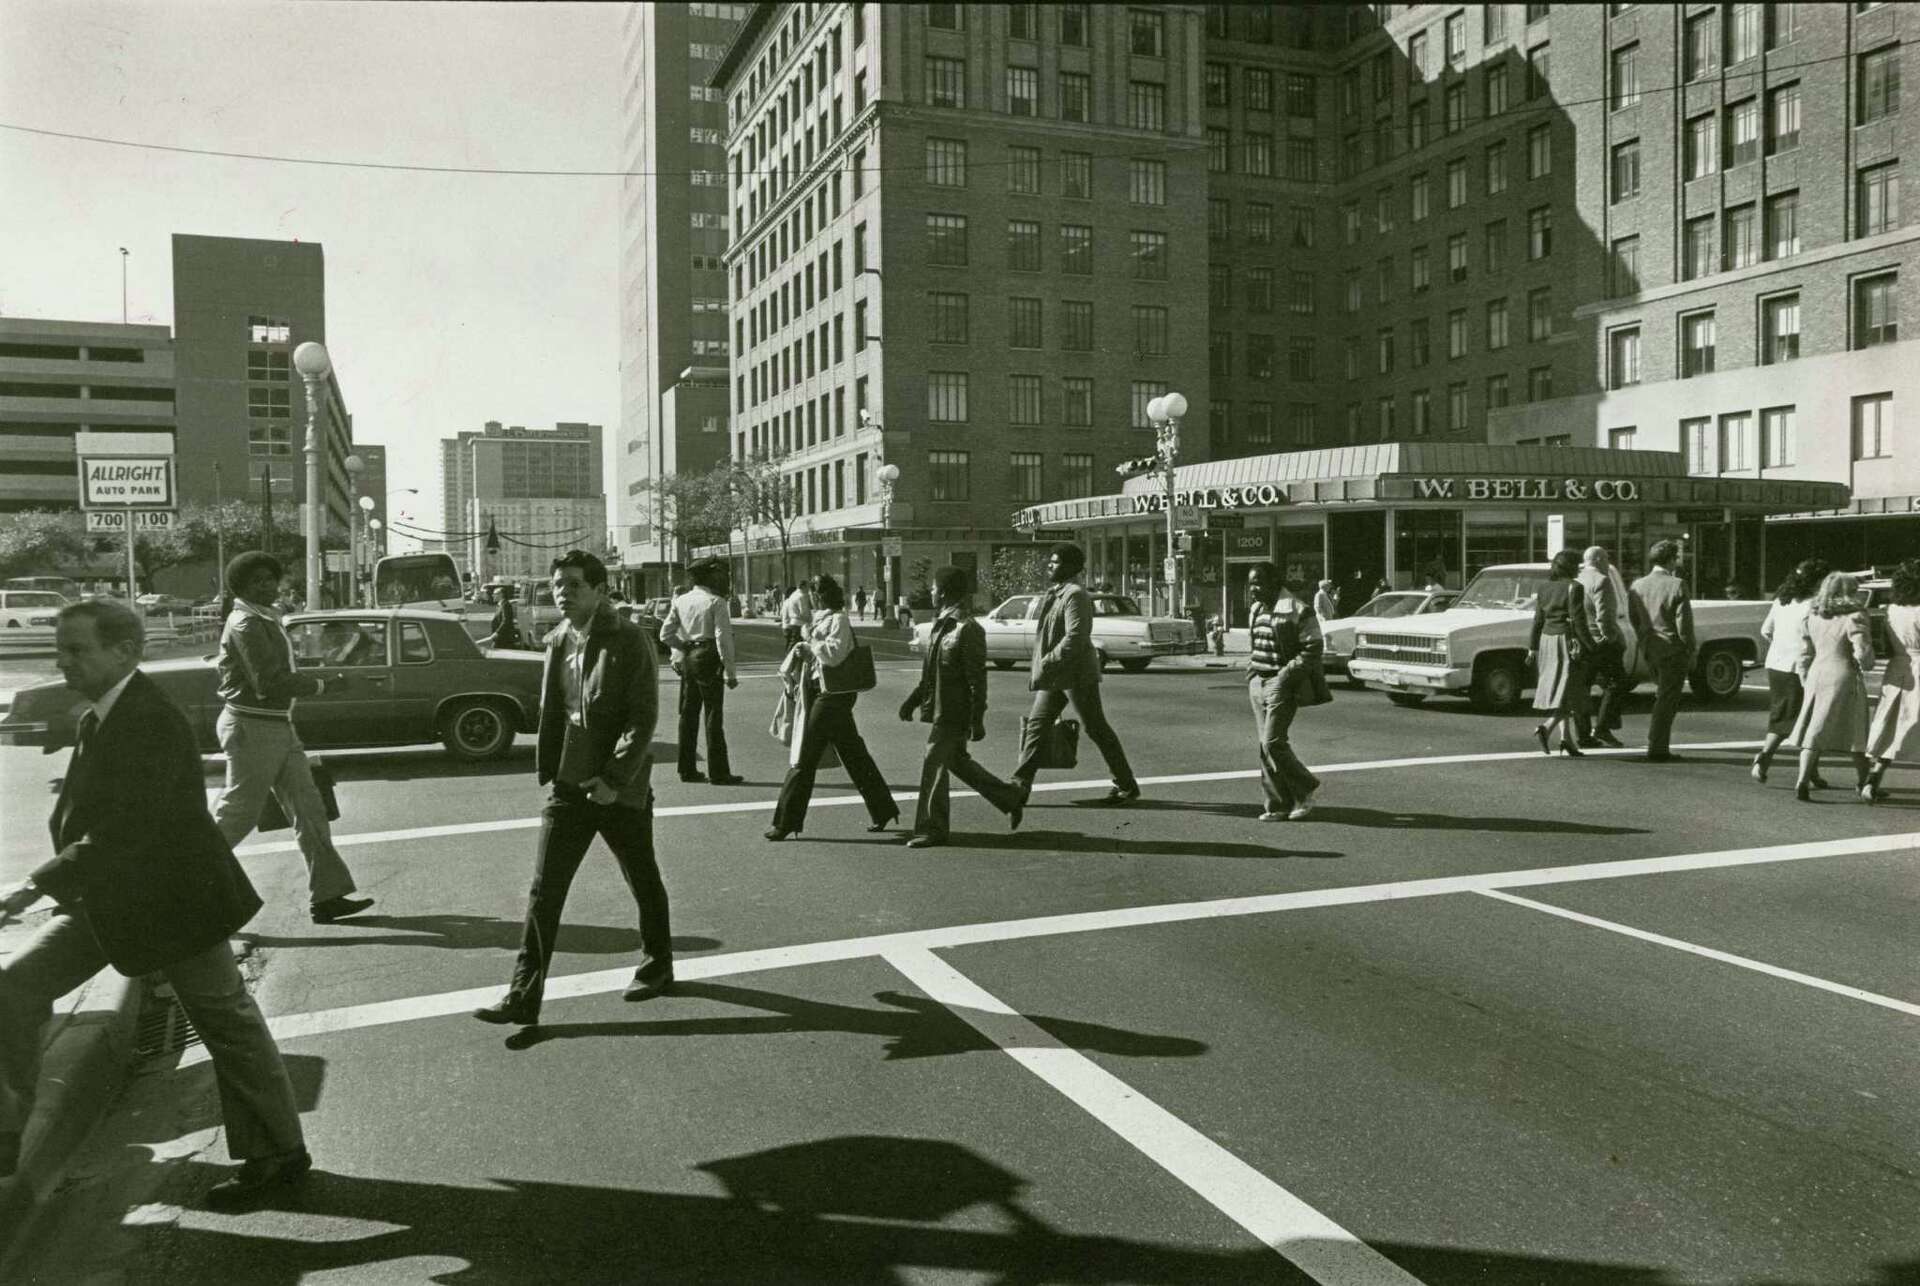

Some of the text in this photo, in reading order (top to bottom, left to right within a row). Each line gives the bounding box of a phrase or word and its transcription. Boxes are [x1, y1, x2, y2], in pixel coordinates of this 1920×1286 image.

[91, 466, 163, 481] ALLRIGHT
[96, 486, 160, 495] AUTO PARK
[1221, 487, 1239, 507] &
[1241, 484, 1279, 506] CO.
[1413, 478, 1638, 501] W. BELL & CO.
[94, 513, 123, 526] 700
[141, 513, 168, 526] 100
[1237, 536, 1263, 548] 1200
